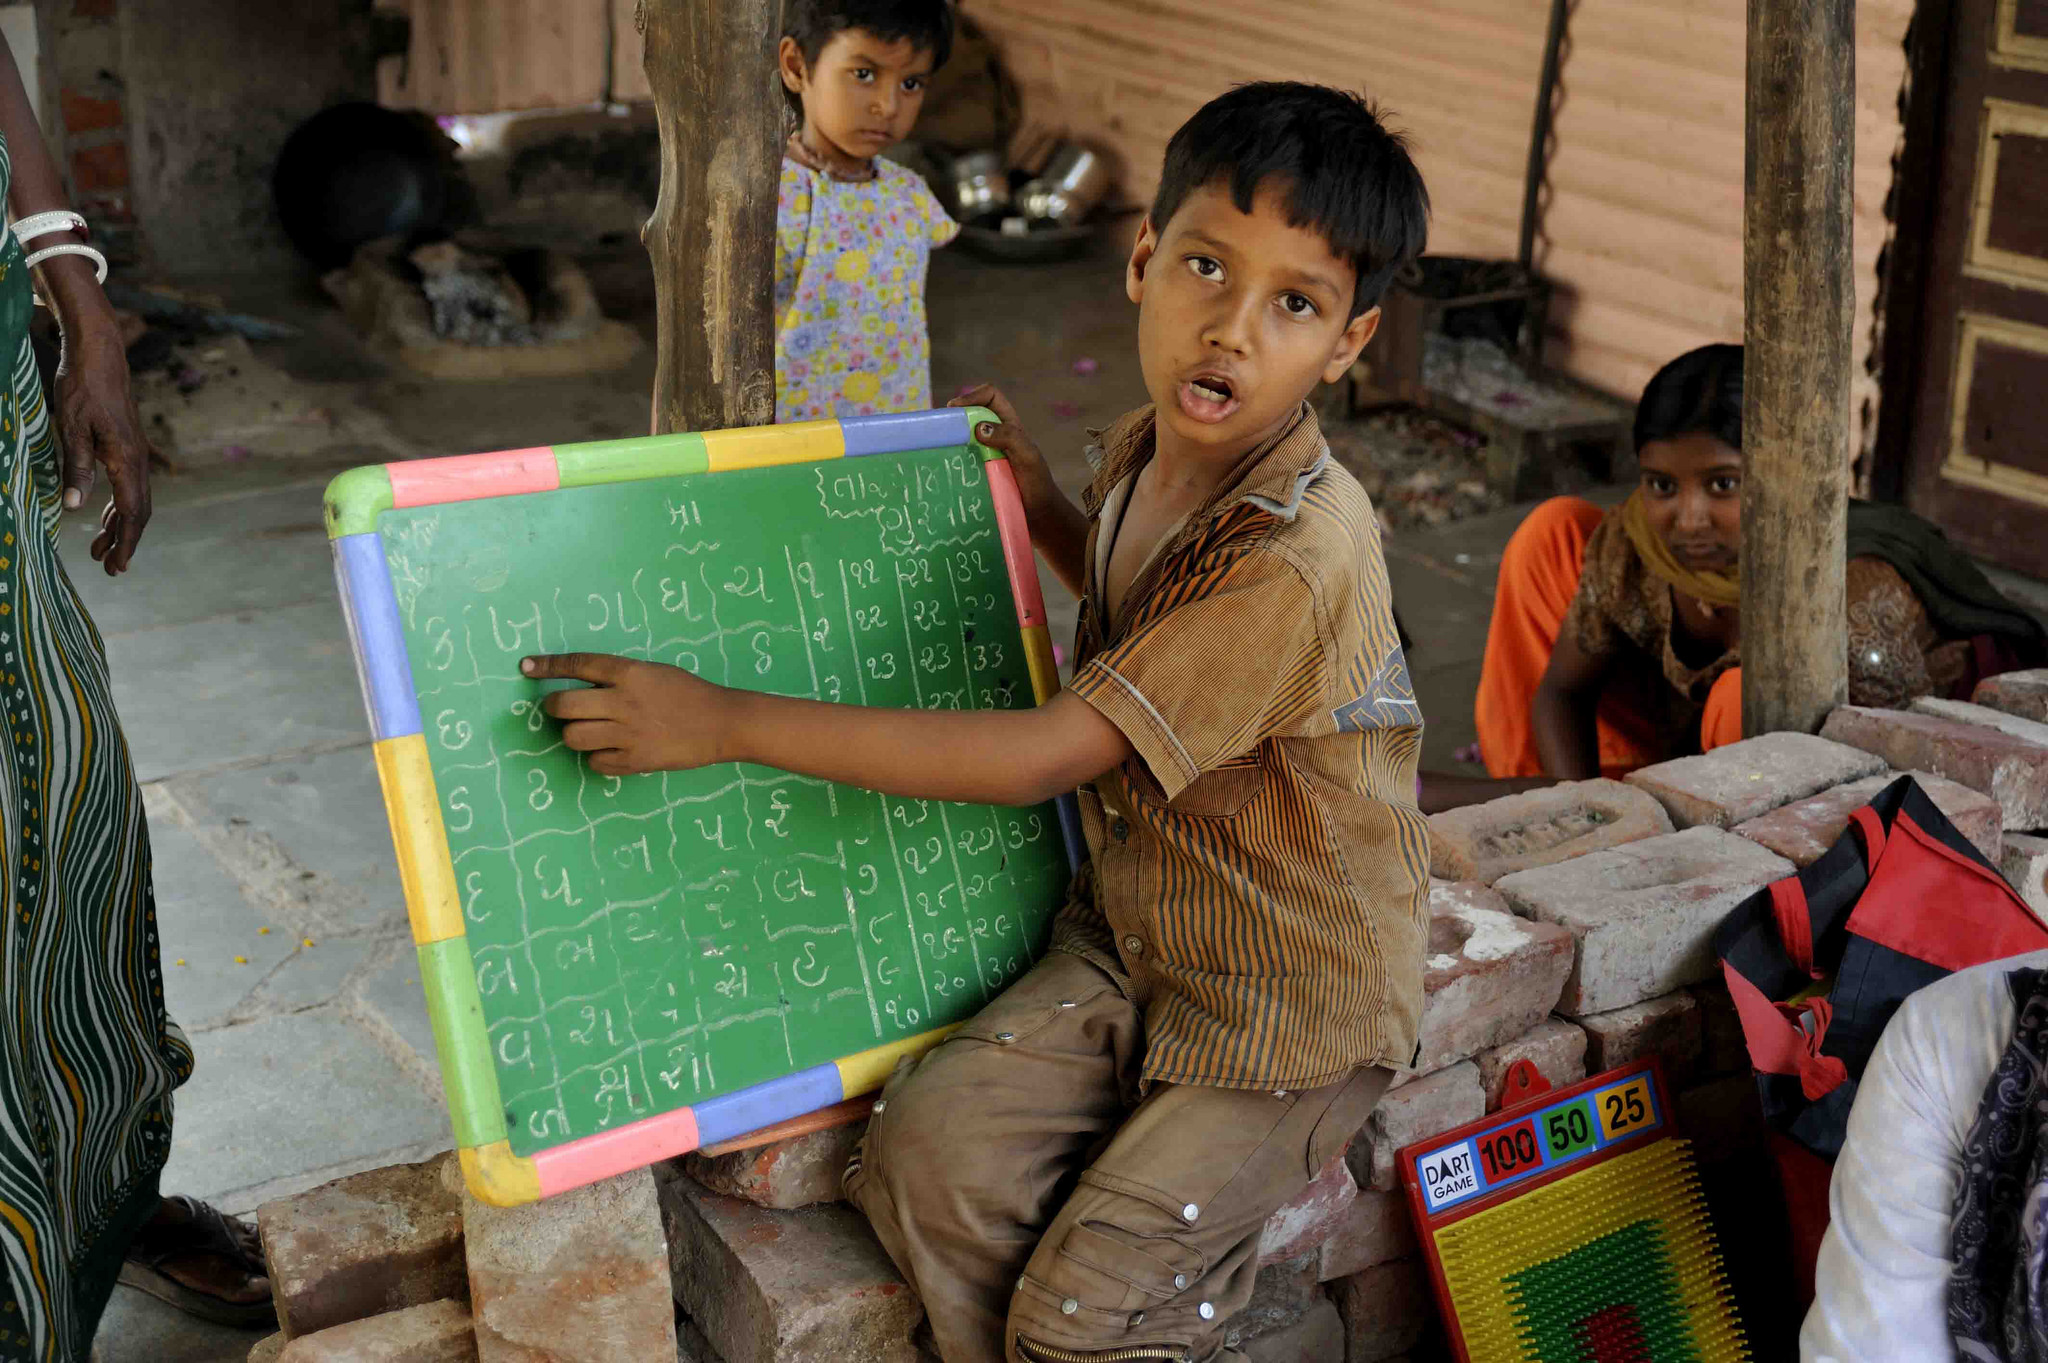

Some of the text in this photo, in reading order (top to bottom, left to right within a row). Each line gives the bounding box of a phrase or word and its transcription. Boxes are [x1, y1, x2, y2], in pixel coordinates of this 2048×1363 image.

[797, 550, 990, 599] ૧ ૧૧ ૨૧ ૩૧
[426, 565, 774, 671] ક ખ ગ ઘ ચ
[813, 617, 834, 652] ૨
[855, 605, 888, 631] ૧૨
[913, 600, 947, 631] ૨૨
[867, 652, 896, 679] ૧૩
[920, 643, 951, 673] ૨૩
[974, 643, 1004, 671] ૩૩
[437, 709, 472, 750] છ
[449, 785, 473, 832] ડ
[466, 789, 792, 922] દ ધ ન પ ફ
[858, 814, 1042, 895] ૭ ૧૭ ૨૭ ૩૭
[477, 956, 519, 995] બ
[556, 934, 596, 970] ભ
[774, 868, 816, 901] લ
[869, 872, 1007, 945] ૮ ૧૮ ૨૮
[877, 914, 1012, 985] ૯ ૧૯ ૨૯
[499, 1030, 535, 1076] વ
[570, 1005, 624, 1046] શ
[792, 941, 830, 986] હ
[885, 956, 1017, 1029] ૧૦ ૨૦ ૩૦
[1482, 1087, 1645, 1175] 100 50 25
[1425, 1152, 1471, 1186] DART
[1434, 1175, 1474, 1199] GAME
